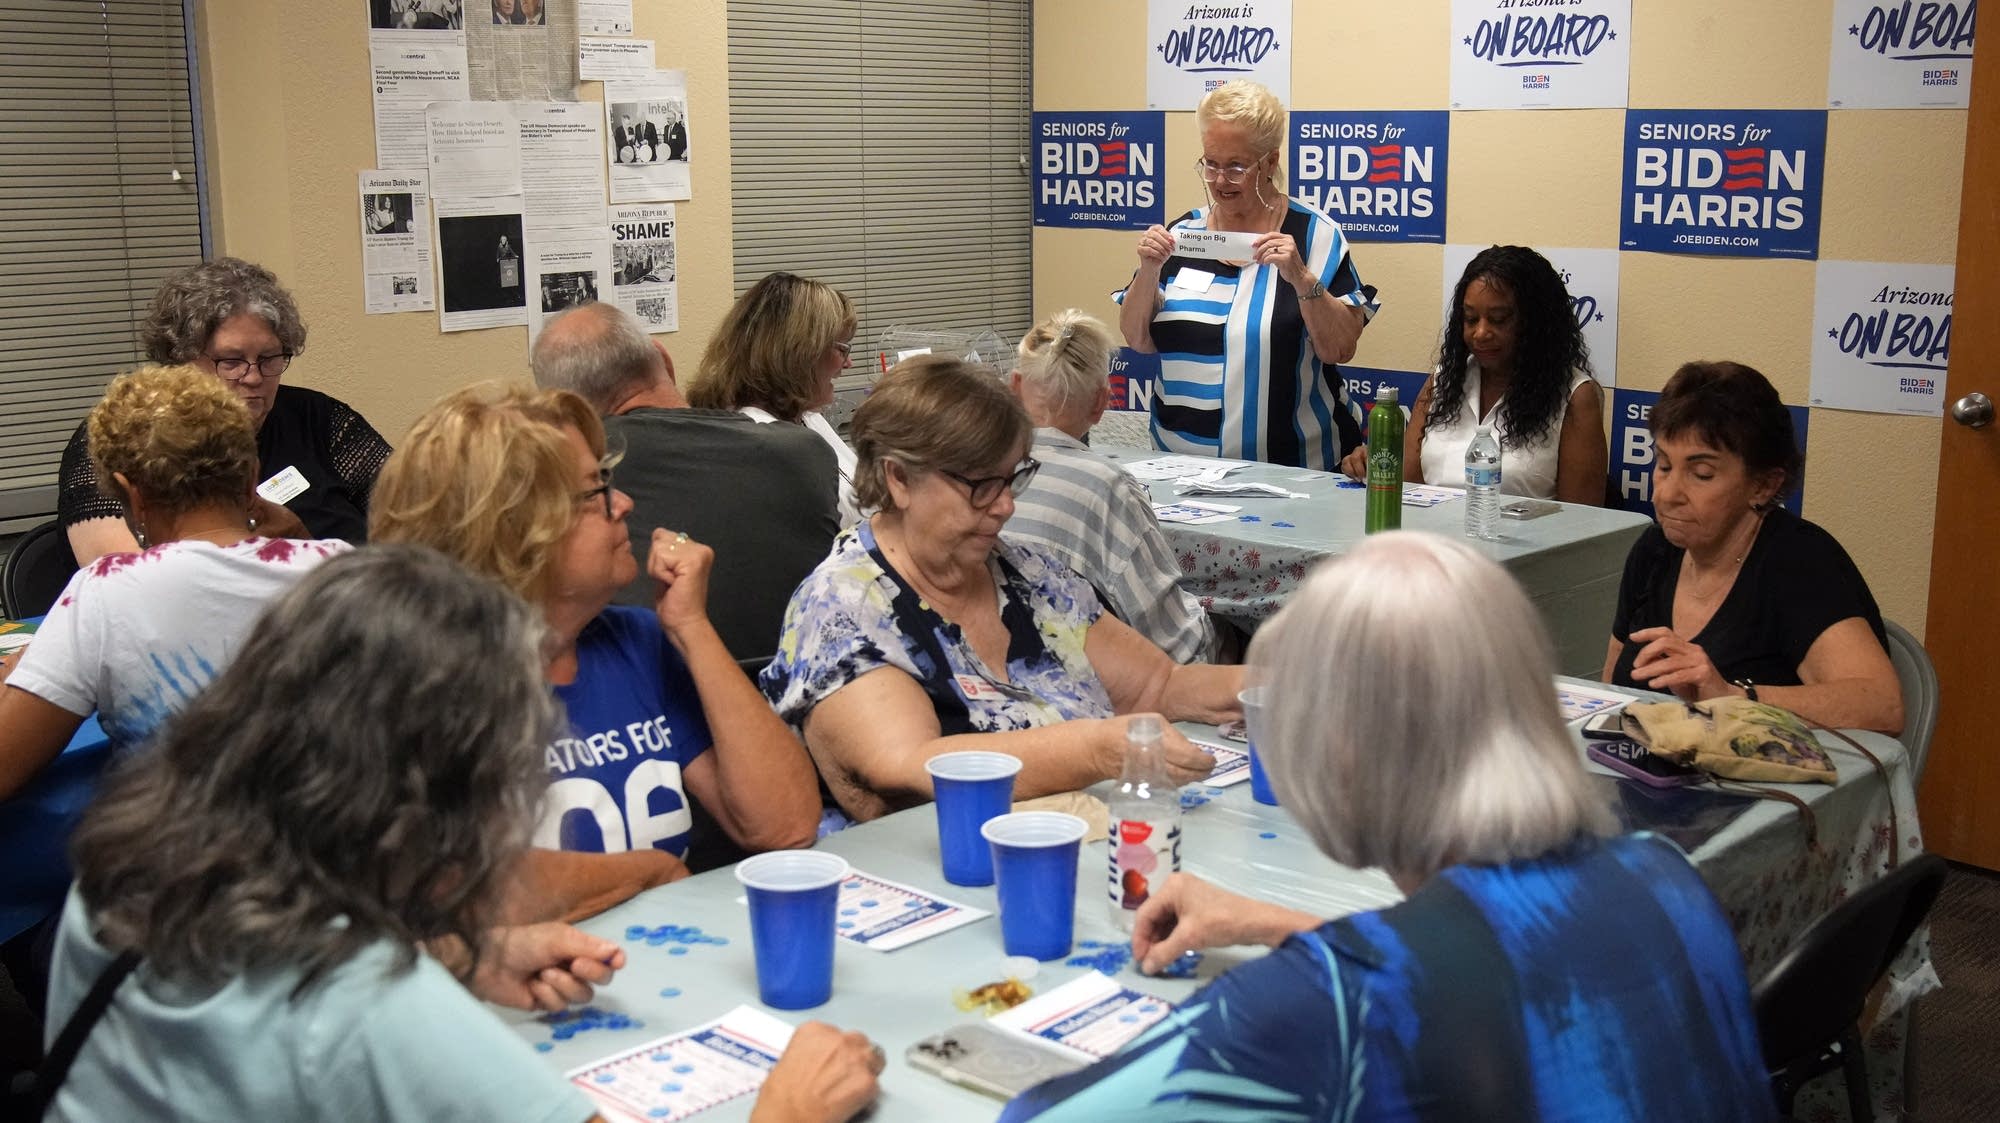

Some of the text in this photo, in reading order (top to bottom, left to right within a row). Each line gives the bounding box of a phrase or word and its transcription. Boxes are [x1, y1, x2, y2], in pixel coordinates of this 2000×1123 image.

[1183, 3, 1253, 20] Arizona is
[1859, 0, 1977, 54] ON BOA
[1164, 25, 1274, 67] ON BOARD
[1472, 13, 1609, 62] ON BOARD
[1522, 74, 1550, 83] BIDEN
[1923, 69, 1958, 79] BIDEN
[1042, 122, 1130, 140] SENIORS for
[1300, 123, 1405, 143] SENIORS for
[1639, 123, 1771, 146] SENIORS for
[1041, 141, 1154, 177] BIDEN
[1298, 144, 1433, 183] BIDEN
[1635, 147, 1806, 191] BIDEN
[369, 178, 421, 187] Arizona Daily Star
[1042, 179, 1155, 208] HARRIS
[1298, 185, 1434, 218] HARRIS
[1069, 212, 1126, 222] JOEBIDEN.COM
[1633, 192, 1804, 231] HARRIS
[1338, 222, 1399, 233] EBIDEN.COM
[1180, 232, 1202, 242] Taking
[1214, 234, 1226, 243] Big
[1673, 234, 1759, 247] JOEBIDEN.COM
[1179, 245, 1206, 253] Pharma
[1839, 308, 1952, 362] ON BOA
[1109, 356, 1129, 374] for
[1899, 386, 1934, 395] HARRIS
[1900, 378, 1935, 388] BIDEN
[1370, 451, 1399, 466] MOUNTAIN
[544, 730, 628, 774] ATORS
